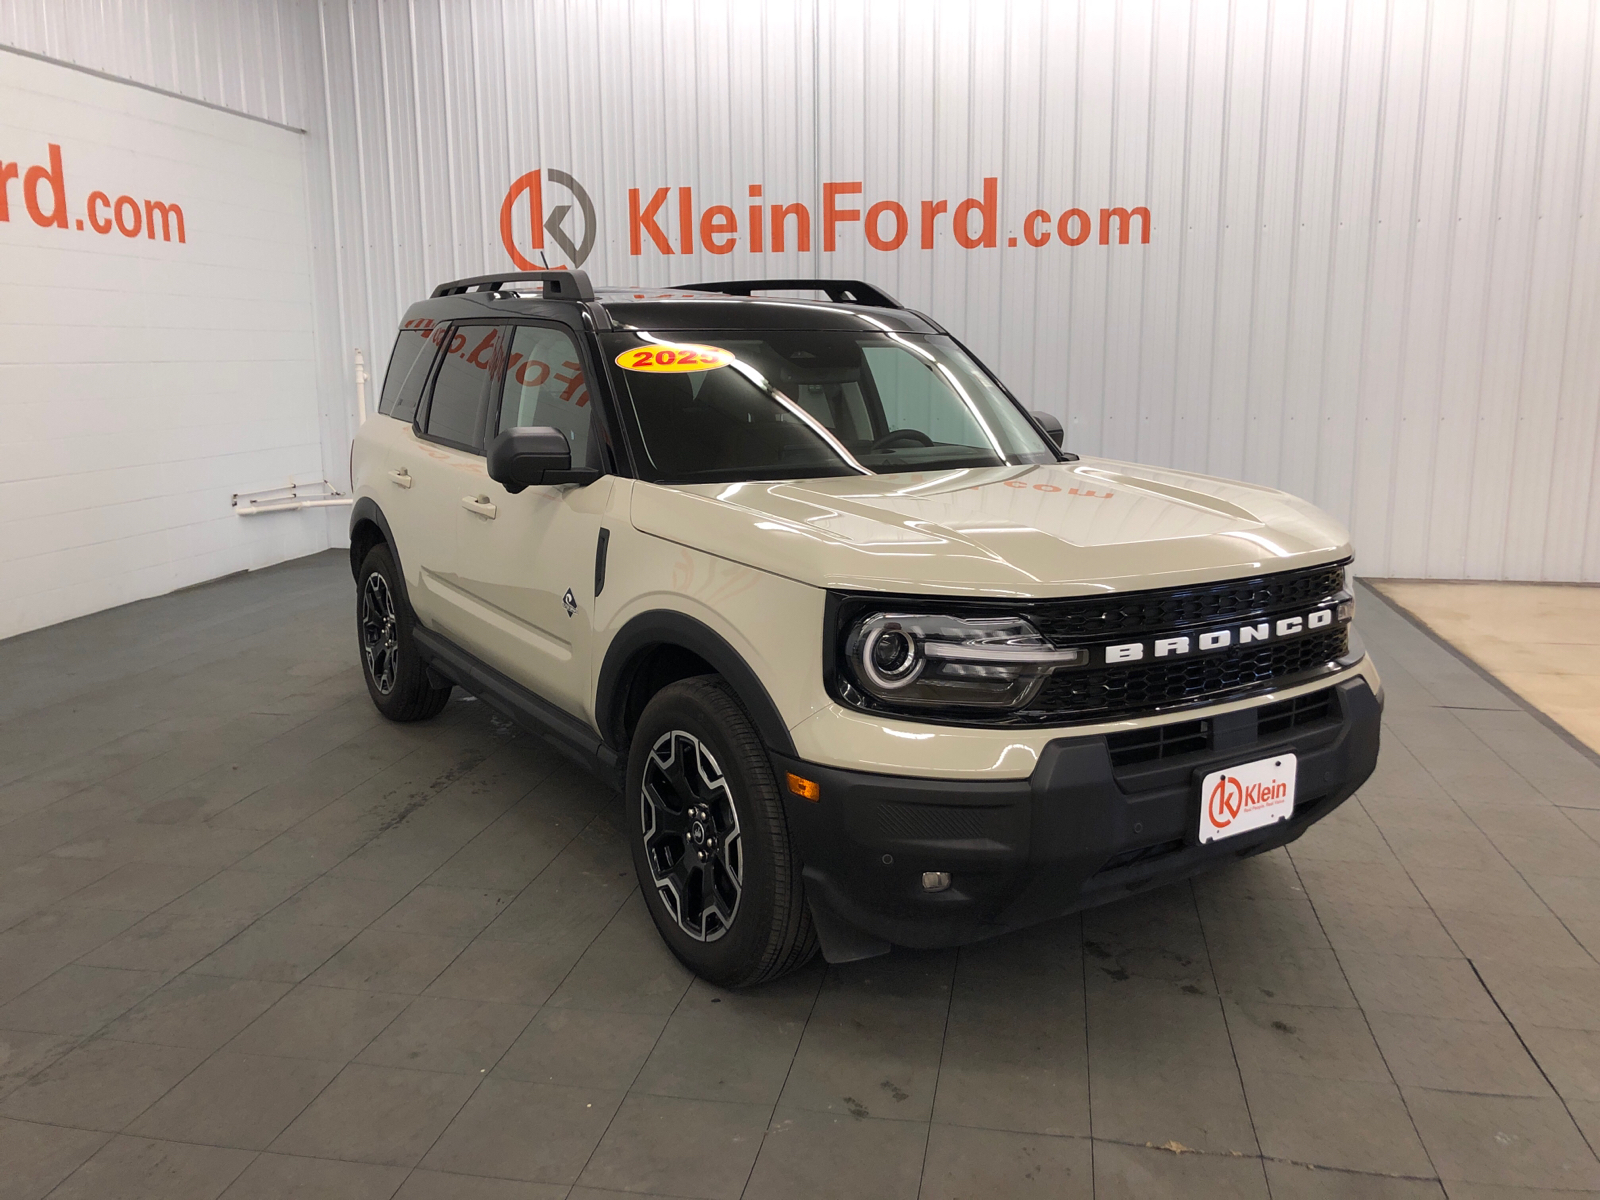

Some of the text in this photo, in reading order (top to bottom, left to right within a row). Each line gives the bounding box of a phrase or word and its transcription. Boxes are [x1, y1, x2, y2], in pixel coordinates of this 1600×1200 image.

[628, 177, 1151, 256] KleinFord.com
[632, 349, 720, 368] 2025
[1105, 609, 1331, 664] BRONCO
[1244, 779, 1287, 807] Klein
